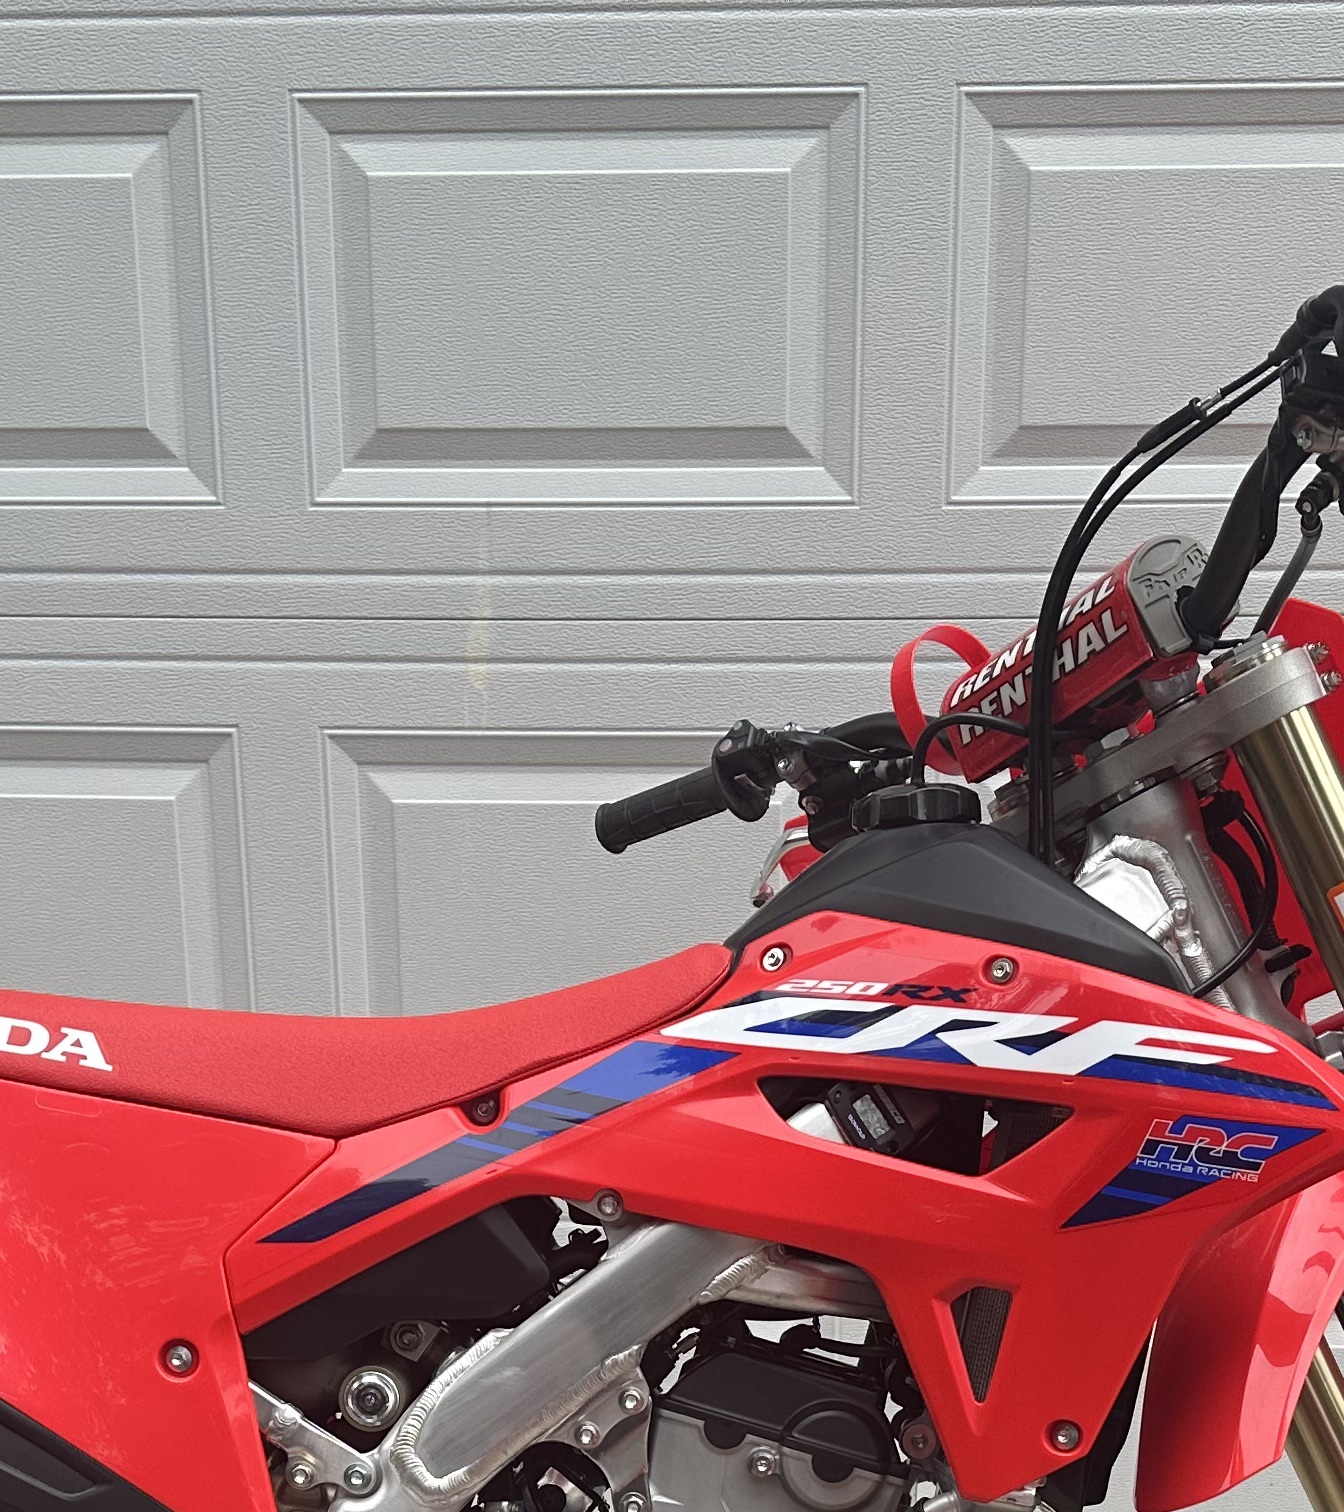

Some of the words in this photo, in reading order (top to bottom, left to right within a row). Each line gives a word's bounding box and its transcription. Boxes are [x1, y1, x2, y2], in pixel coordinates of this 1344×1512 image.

[958, 608, 1129, 746] RENHAL
[774, 978, 980, 1004] 250RX
[658, 996, 1279, 1077] CRF
[1137, 1118, 1279, 1174] HRC
[1196, 1165, 1260, 1183] RACING
